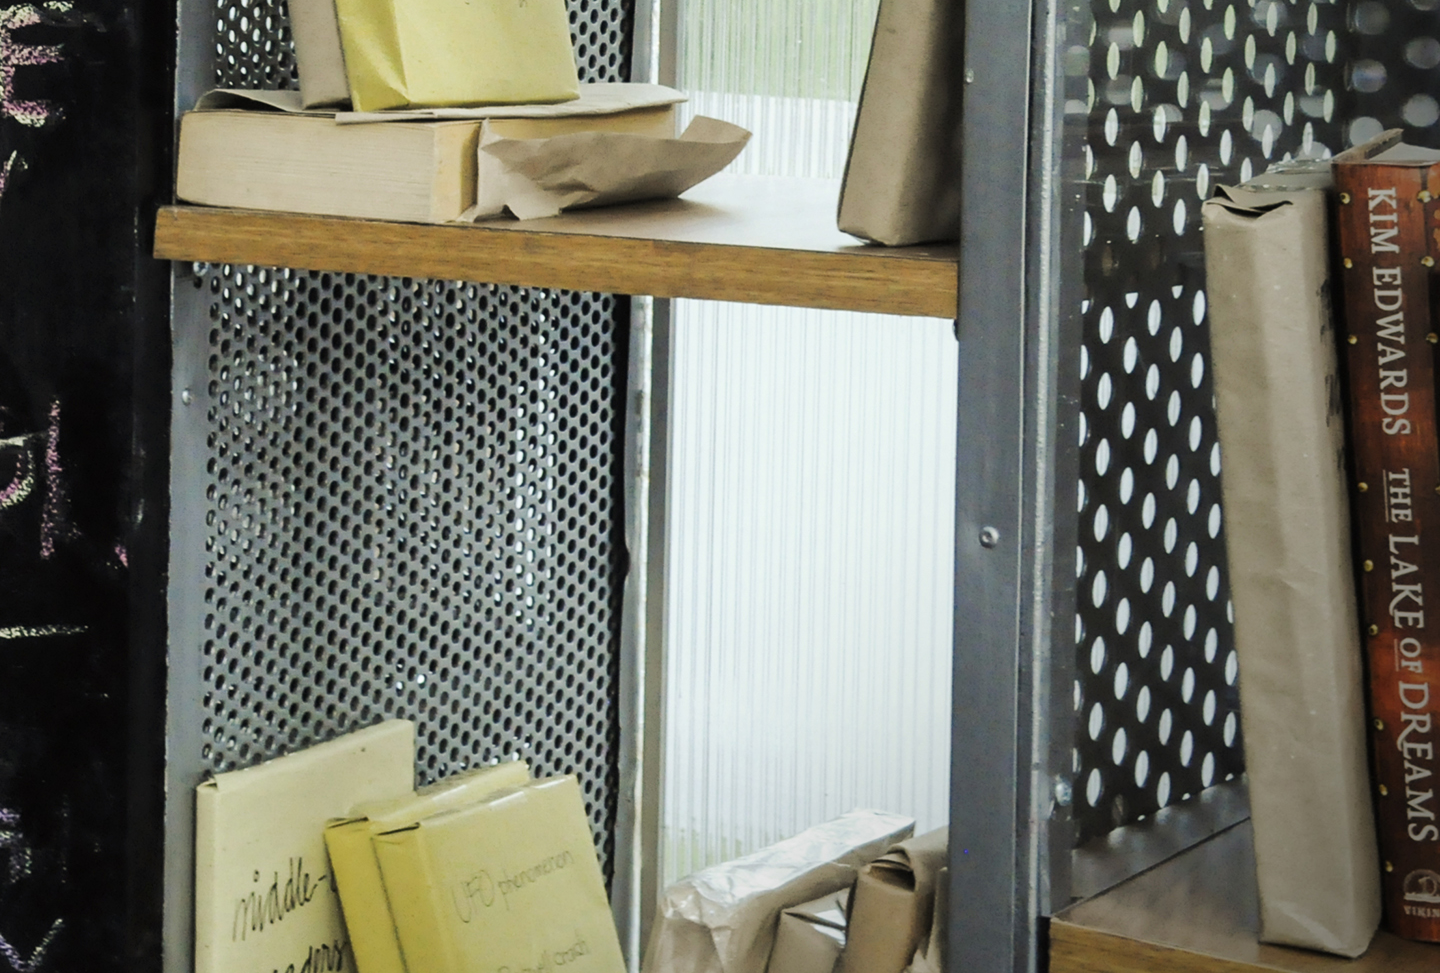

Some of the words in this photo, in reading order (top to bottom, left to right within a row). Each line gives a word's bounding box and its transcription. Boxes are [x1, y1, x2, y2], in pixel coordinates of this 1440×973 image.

[1367, 187, 1400, 255] KIM
[1372, 266, 1411, 436] EDWARDS
[1387, 468, 1413, 524] THE
[1388, 533, 1426, 630] LAKE
[1399, 636, 1423, 675] OF
[1397, 681, 1440, 842] DREAMS
